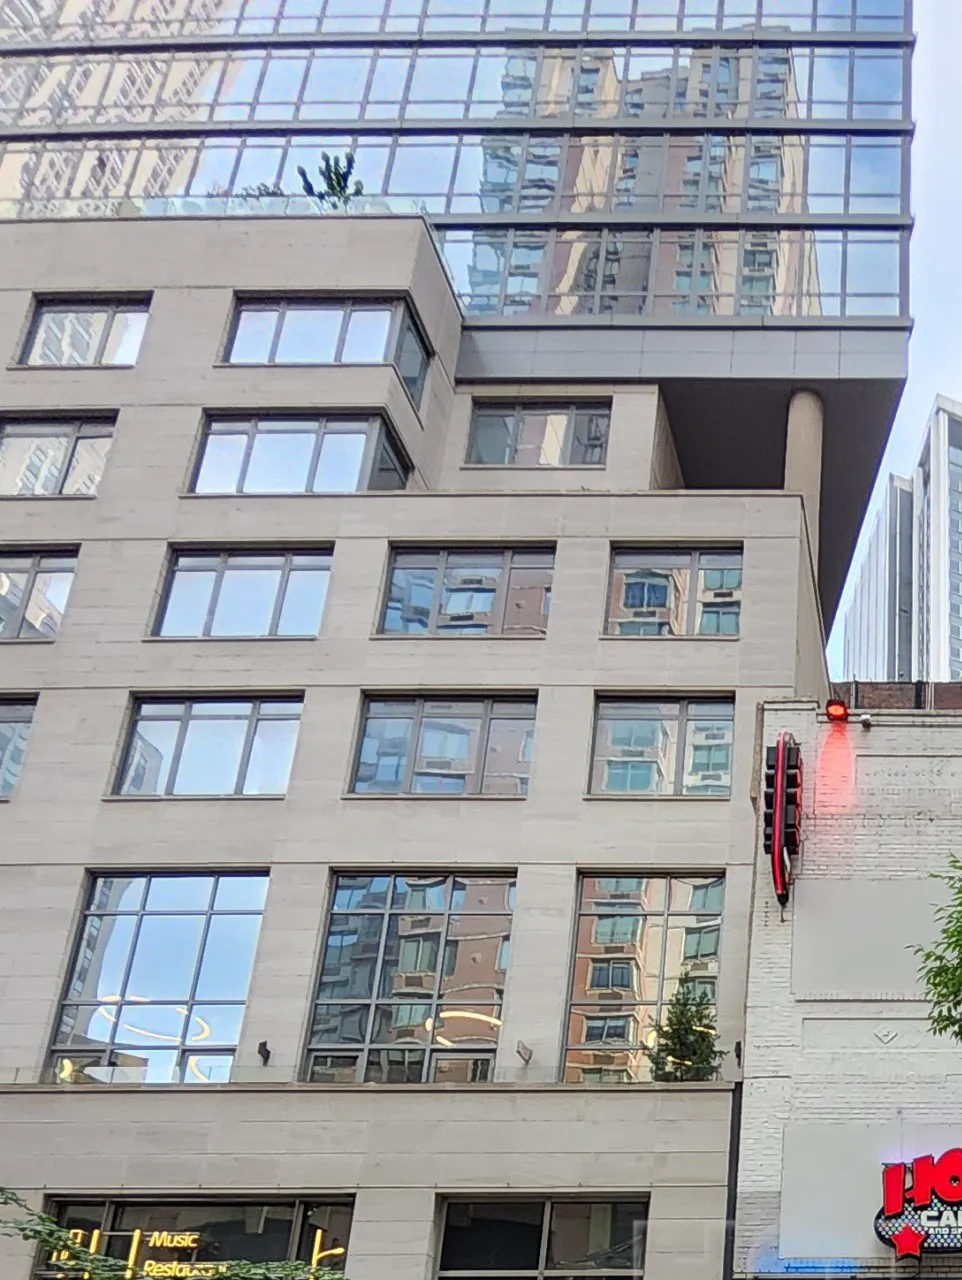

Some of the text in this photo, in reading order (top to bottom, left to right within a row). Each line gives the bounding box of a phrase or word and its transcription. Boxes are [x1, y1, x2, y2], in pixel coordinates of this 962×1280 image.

[148, 1231, 199, 1248] Music
[928, 1227, 951, 1235] AND
[143, 1260, 229, 1277] Restauran
